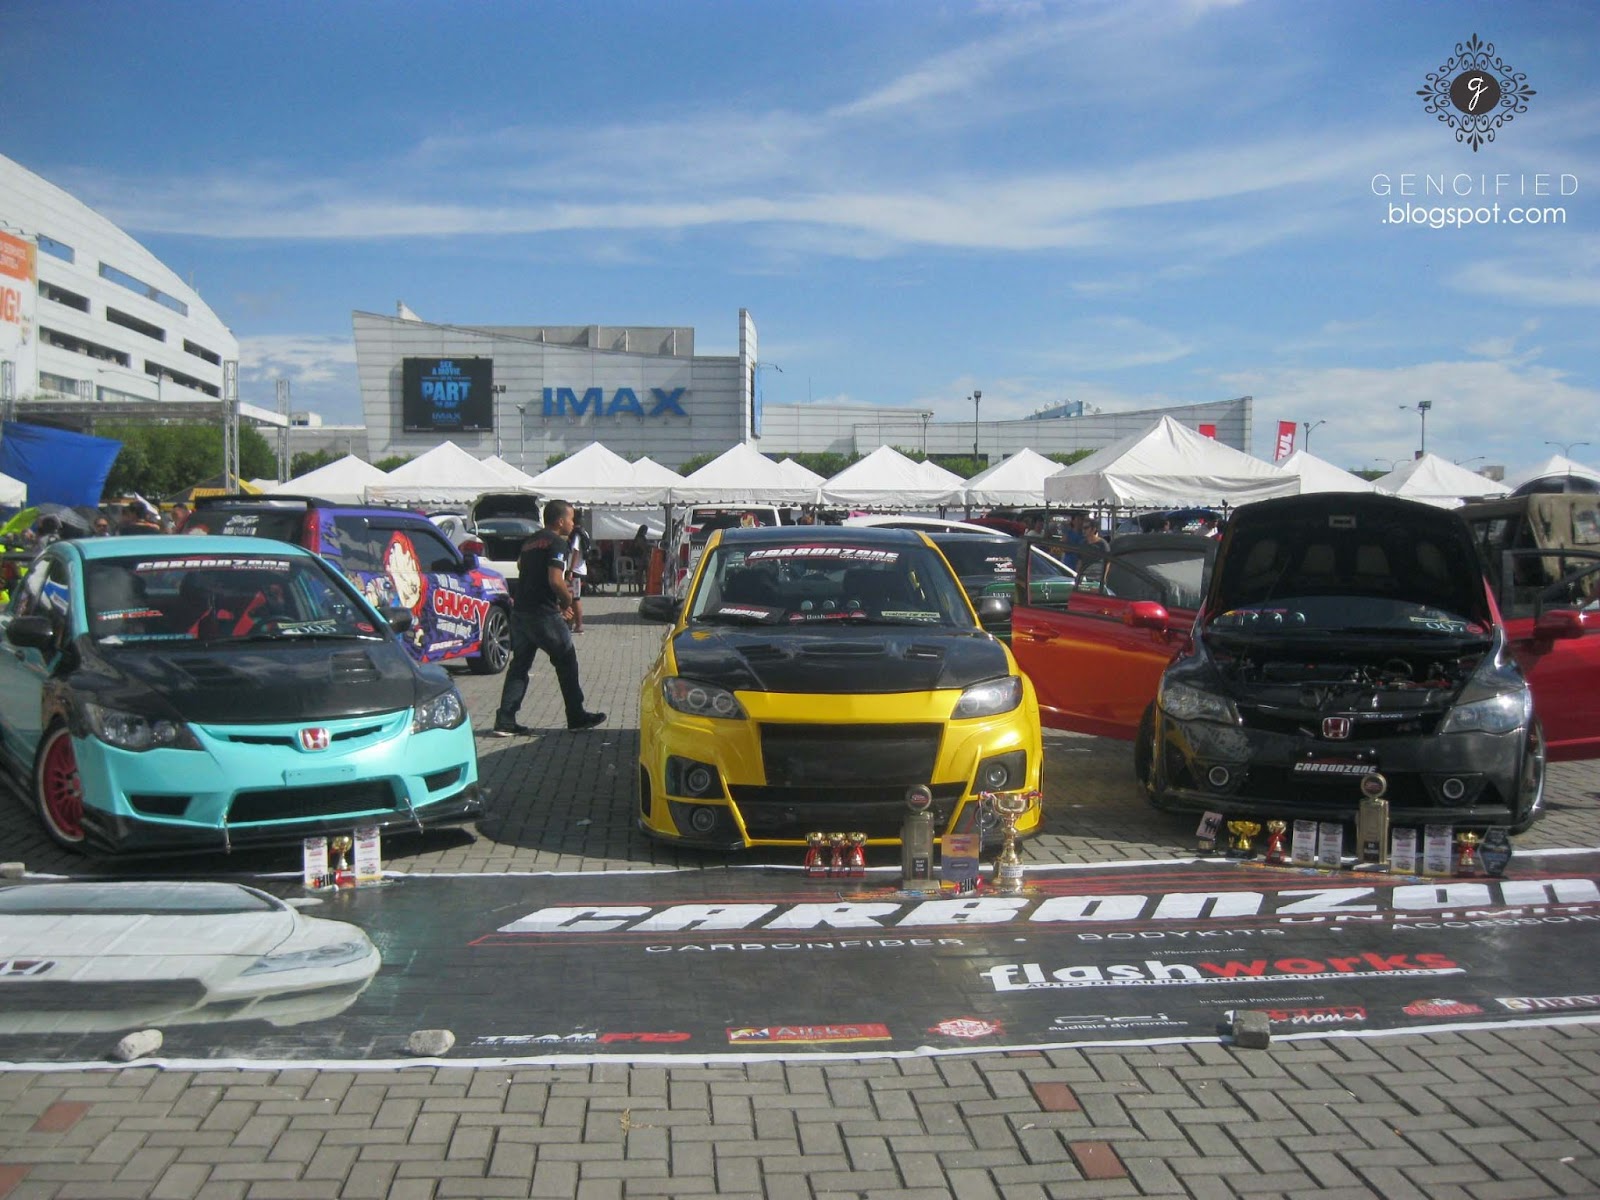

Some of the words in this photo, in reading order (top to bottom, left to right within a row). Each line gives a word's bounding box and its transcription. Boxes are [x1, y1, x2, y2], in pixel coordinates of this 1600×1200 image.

[421, 381, 472, 401] PART
[541, 386, 689, 418] IMAX
[748, 547, 900, 559] CARBONZONE
[136, 559, 291, 571] CARBONZONE
[433, 588, 490, 641] CHUCKY
[1294, 762, 1378, 774] CARBONZONE
[1077, 928, 1285, 940] BODYKITS
[1091, 978, 1197, 986] DETAILING
[1254, 973, 1349, 981] LIGHTING
[1355, 969, 1438, 977] SERVICES
[1048, 1023, 1107, 1031] audible
[476, 1032, 597, 1042] TEAM
